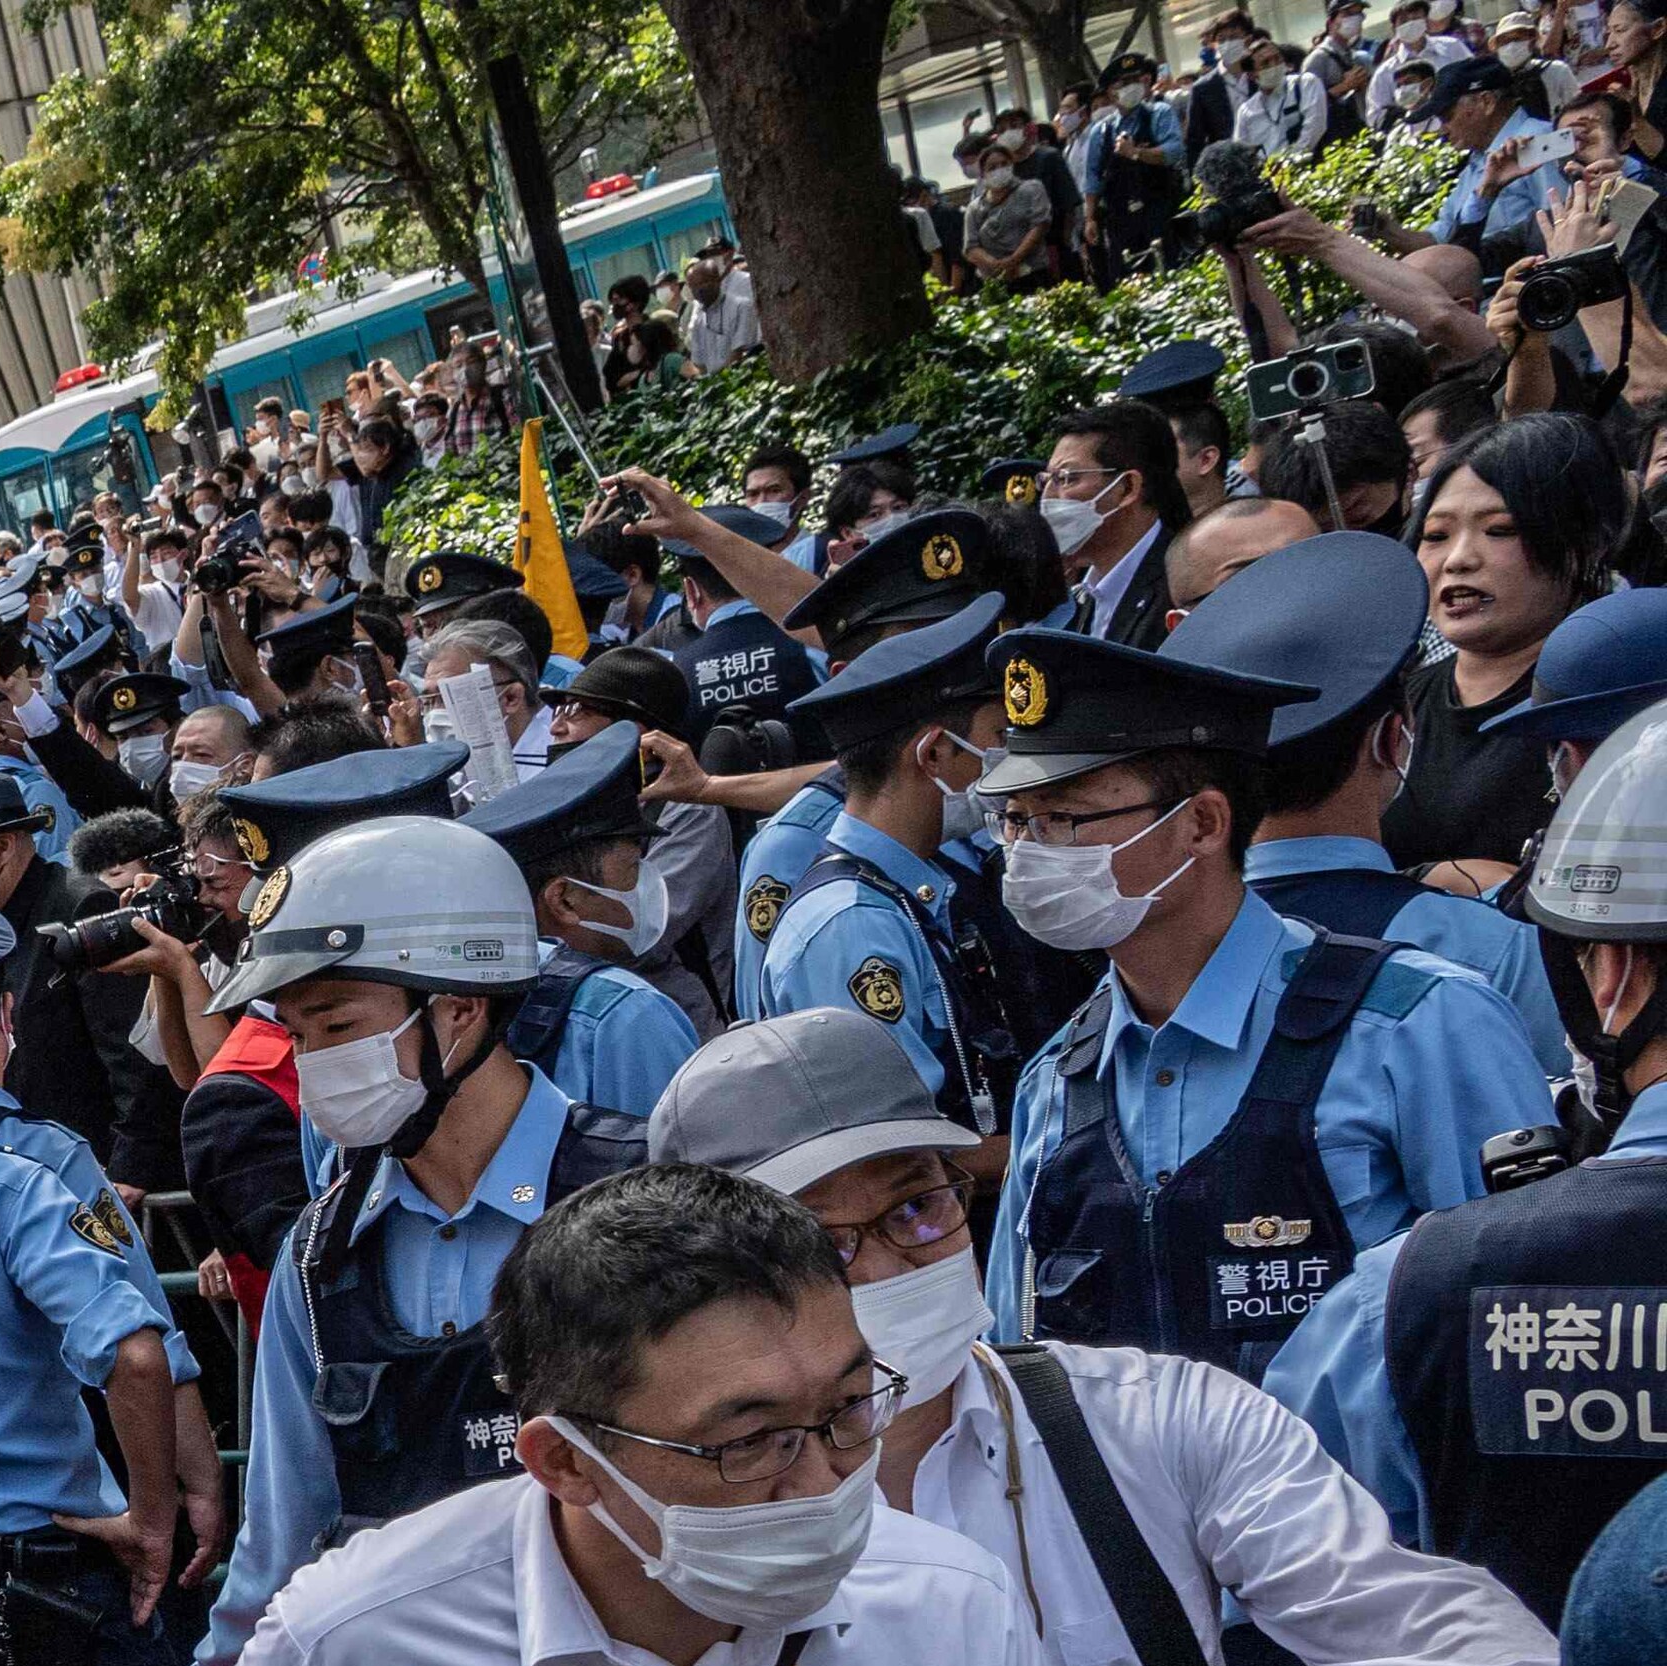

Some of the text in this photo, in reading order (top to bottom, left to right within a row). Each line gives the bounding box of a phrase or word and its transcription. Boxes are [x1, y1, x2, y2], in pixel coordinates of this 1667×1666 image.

[695, 647, 776, 685] 警視庁
[700, 674, 779, 706] POLICE
[1217, 1257, 1329, 1295] 警視庁
[464, 1412, 522, 1449] 神奈
